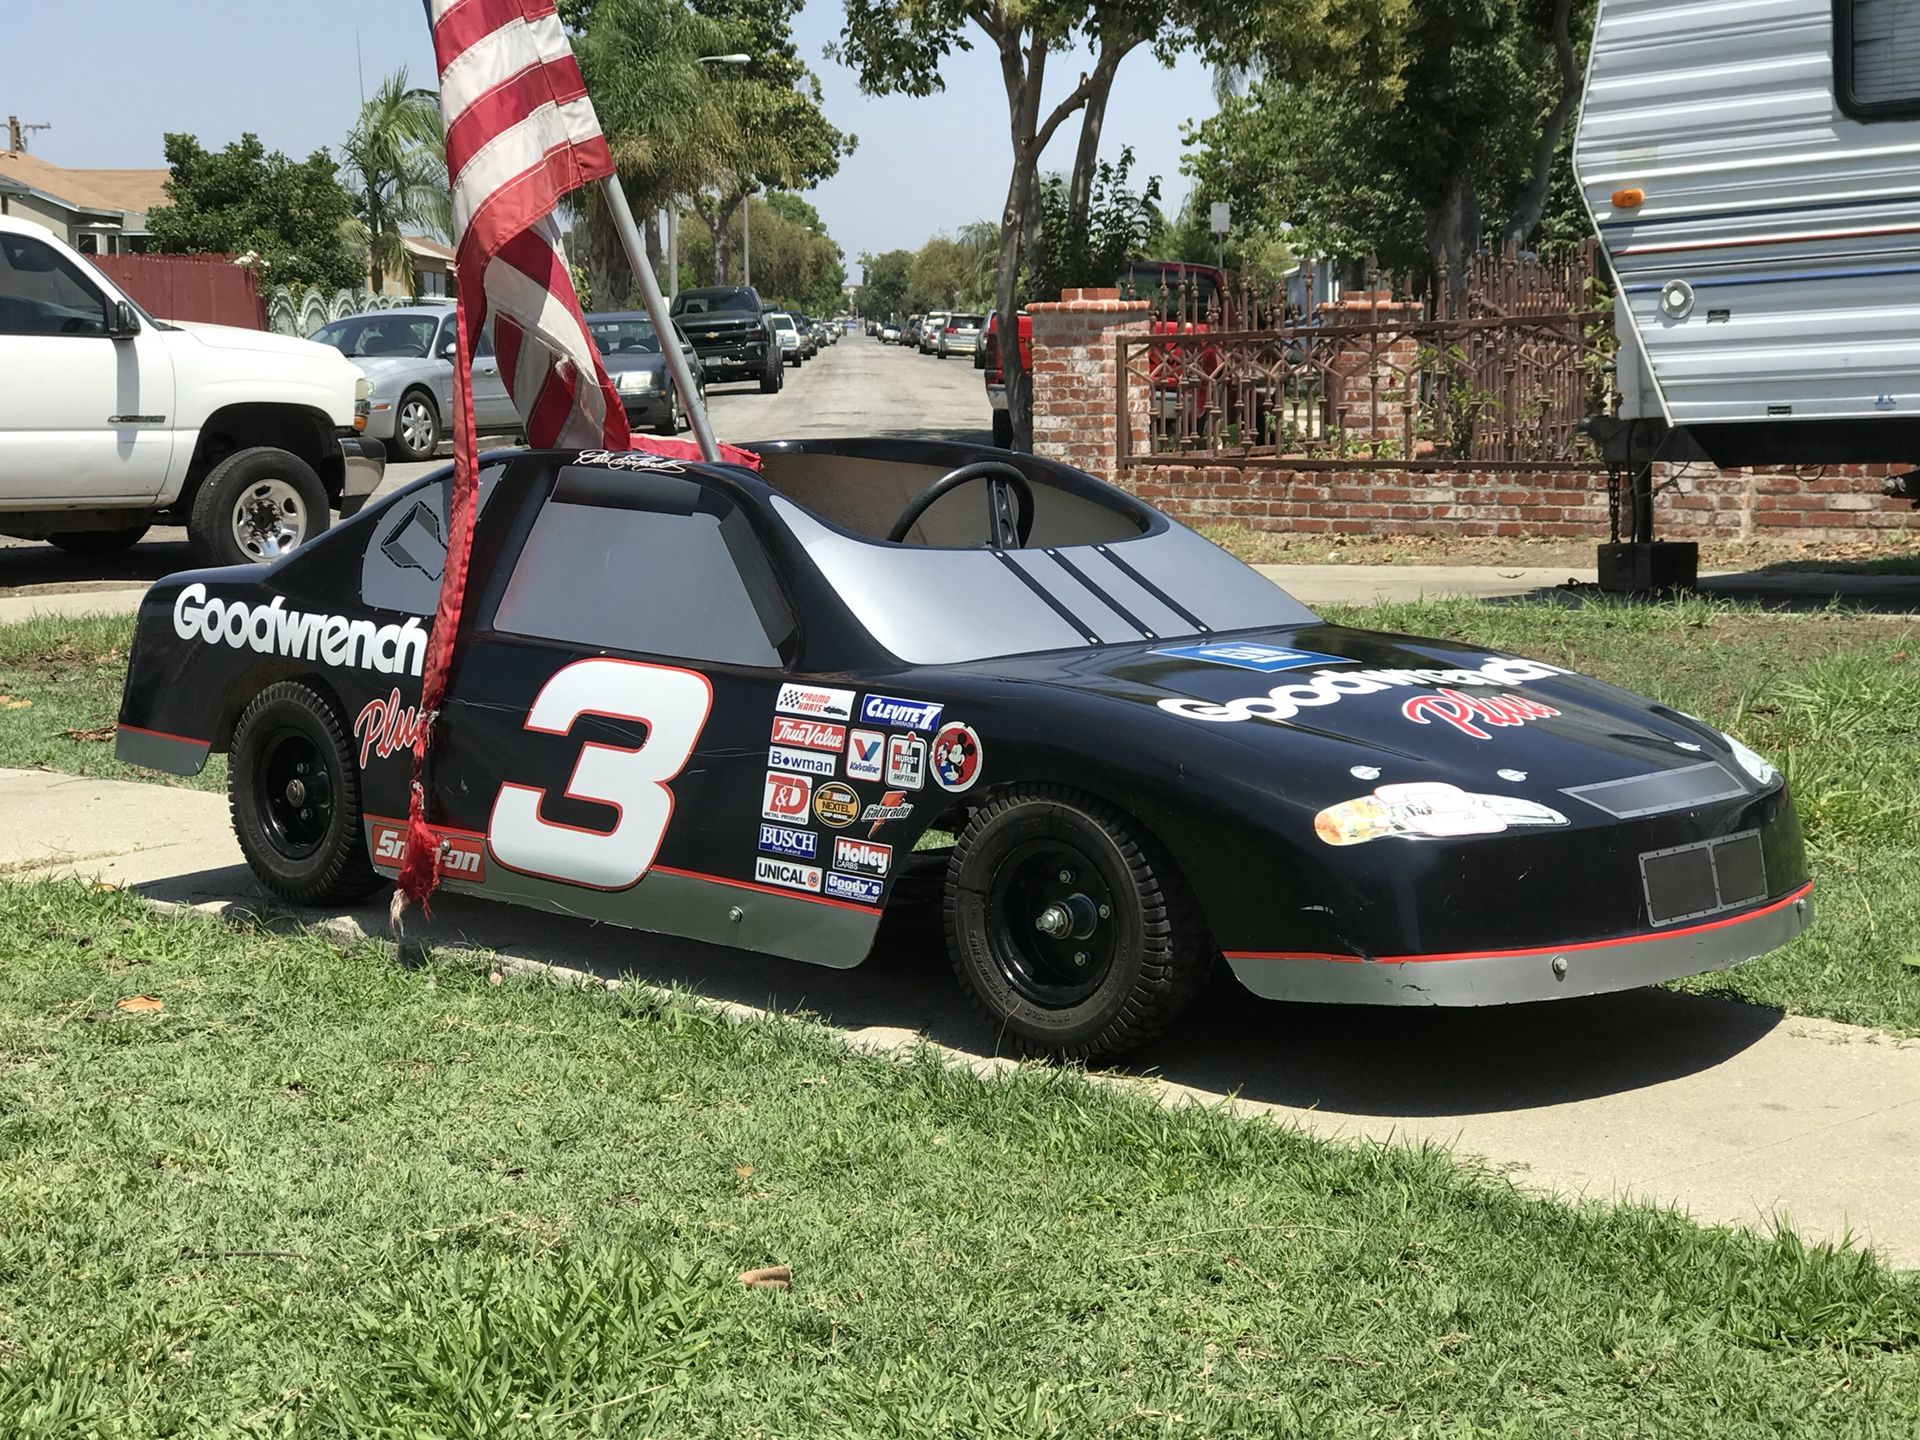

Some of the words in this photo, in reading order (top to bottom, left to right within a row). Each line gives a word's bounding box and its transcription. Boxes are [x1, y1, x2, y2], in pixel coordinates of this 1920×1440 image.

[174, 583, 428, 677] Goodwrench
[802, 692, 831, 704] PROMO
[797, 702, 823, 713] KARTS
[1402, 688, 1562, 740] Plus
[354, 687, 420, 770] Plu
[895, 754, 918, 765] HURST
[487, 657, 714, 892] 3
[849, 761, 880, 774] Valvoline
[893, 773, 917, 783] SHIFTERS
[821, 801, 850, 813] NEXTEL
[864, 805, 910, 819] Gatorade
[781, 814, 807, 823] PRODUCTS
[761, 826, 815, 852] BUSCH
[376, 829, 481, 873] Sn-on
[837, 841, 888, 874] Holley
[836, 860, 859, 871] CARBS
[829, 875, 880, 895] Goody's
